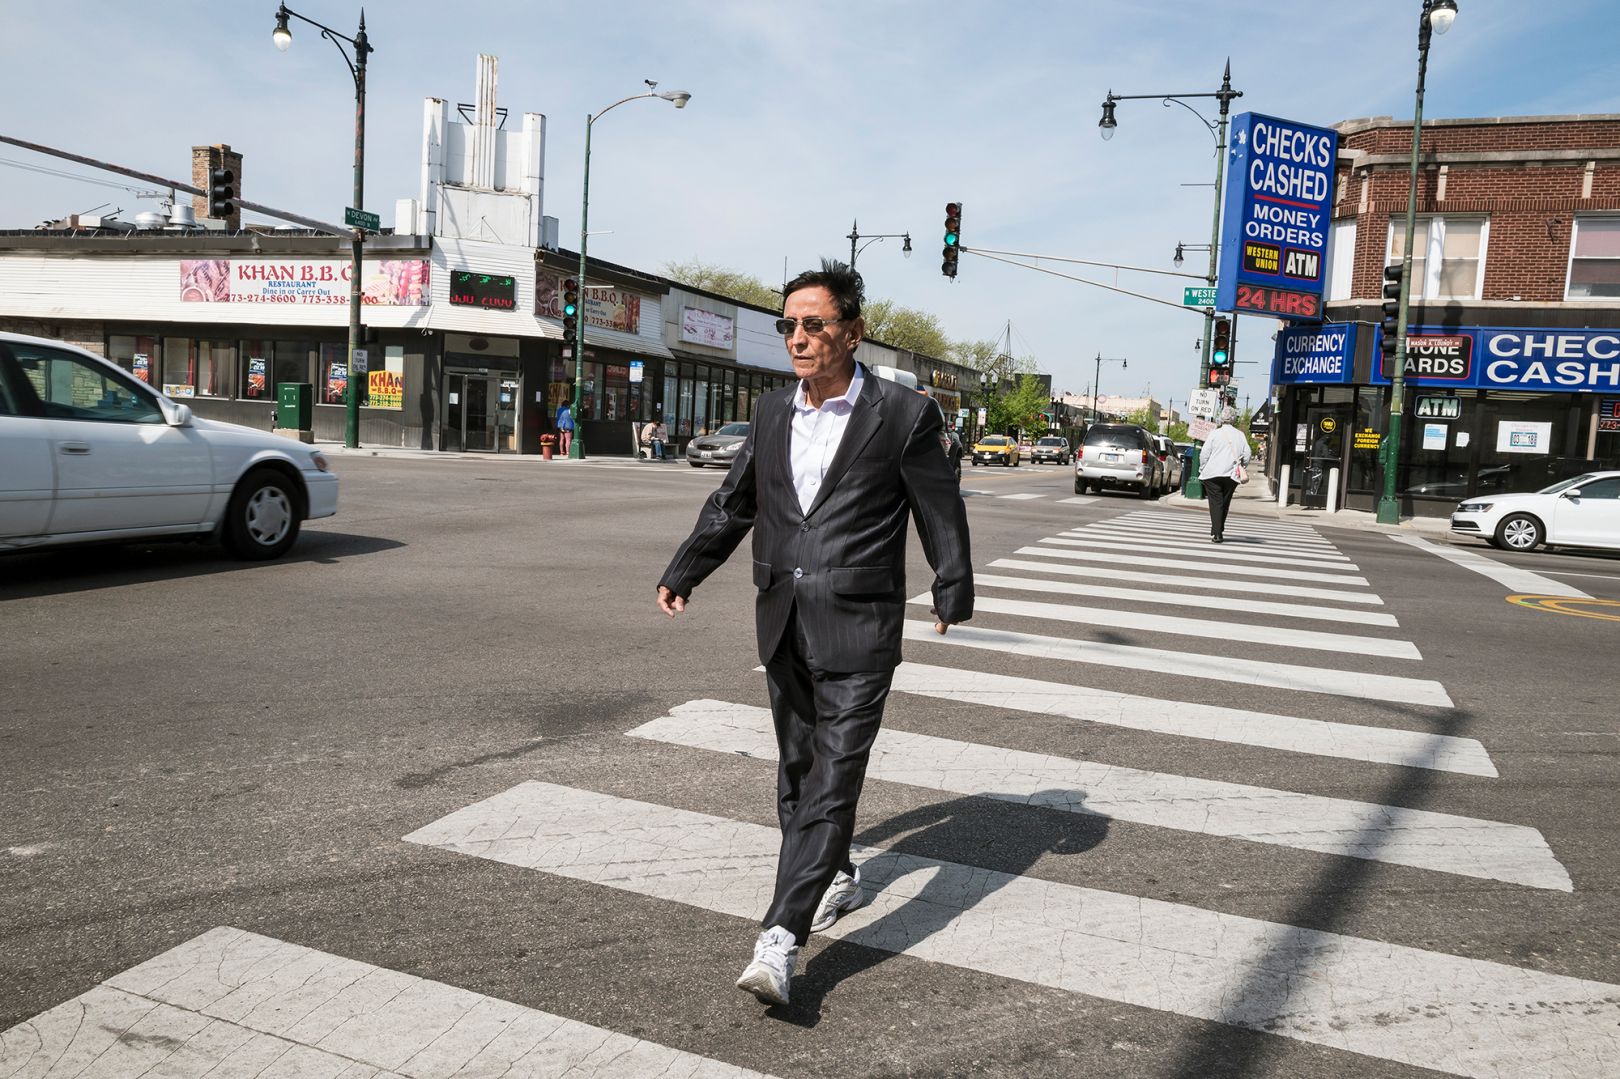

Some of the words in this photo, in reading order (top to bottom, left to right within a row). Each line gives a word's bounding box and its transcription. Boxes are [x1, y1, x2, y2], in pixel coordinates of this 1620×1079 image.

[1252, 122, 1331, 168] CHECKS
[1249, 158, 1328, 201] CASHED
[351, 210, 372, 222] DEVON
[1253, 203, 1321, 229] MONEY
[1245, 221, 1323, 248] ORDERS
[1246, 245, 1279, 260] WESTERN
[238, 264, 295, 281] KHAN
[1255, 258, 1278, 271] UNION
[1285, 252, 1318, 277] ATM
[262, 287, 277, 295] Dine
[296, 288, 315, 297] Carry
[268, 281, 317, 289] RESTAURANT
[1191, 289, 1217, 298] WESTE
[225, 294, 296, 303] 773-274-8600
[302, 295, 378, 305] 773-338-00
[1236, 286, 1266, 310] 24
[1269, 291, 1317, 316] HRS
[1286, 333, 1346, 353] CURRENCY
[1405, 337, 1460, 355] HONE
[1488, 334, 1620, 359] CHEC
[1284, 356, 1343, 375] EXCHANGE
[1404, 357, 1465, 375] ARDS
[1486, 360, 1620, 386] CASH
[370, 372, 404, 388] KHAN
[1417, 398, 1459, 417] ATM
